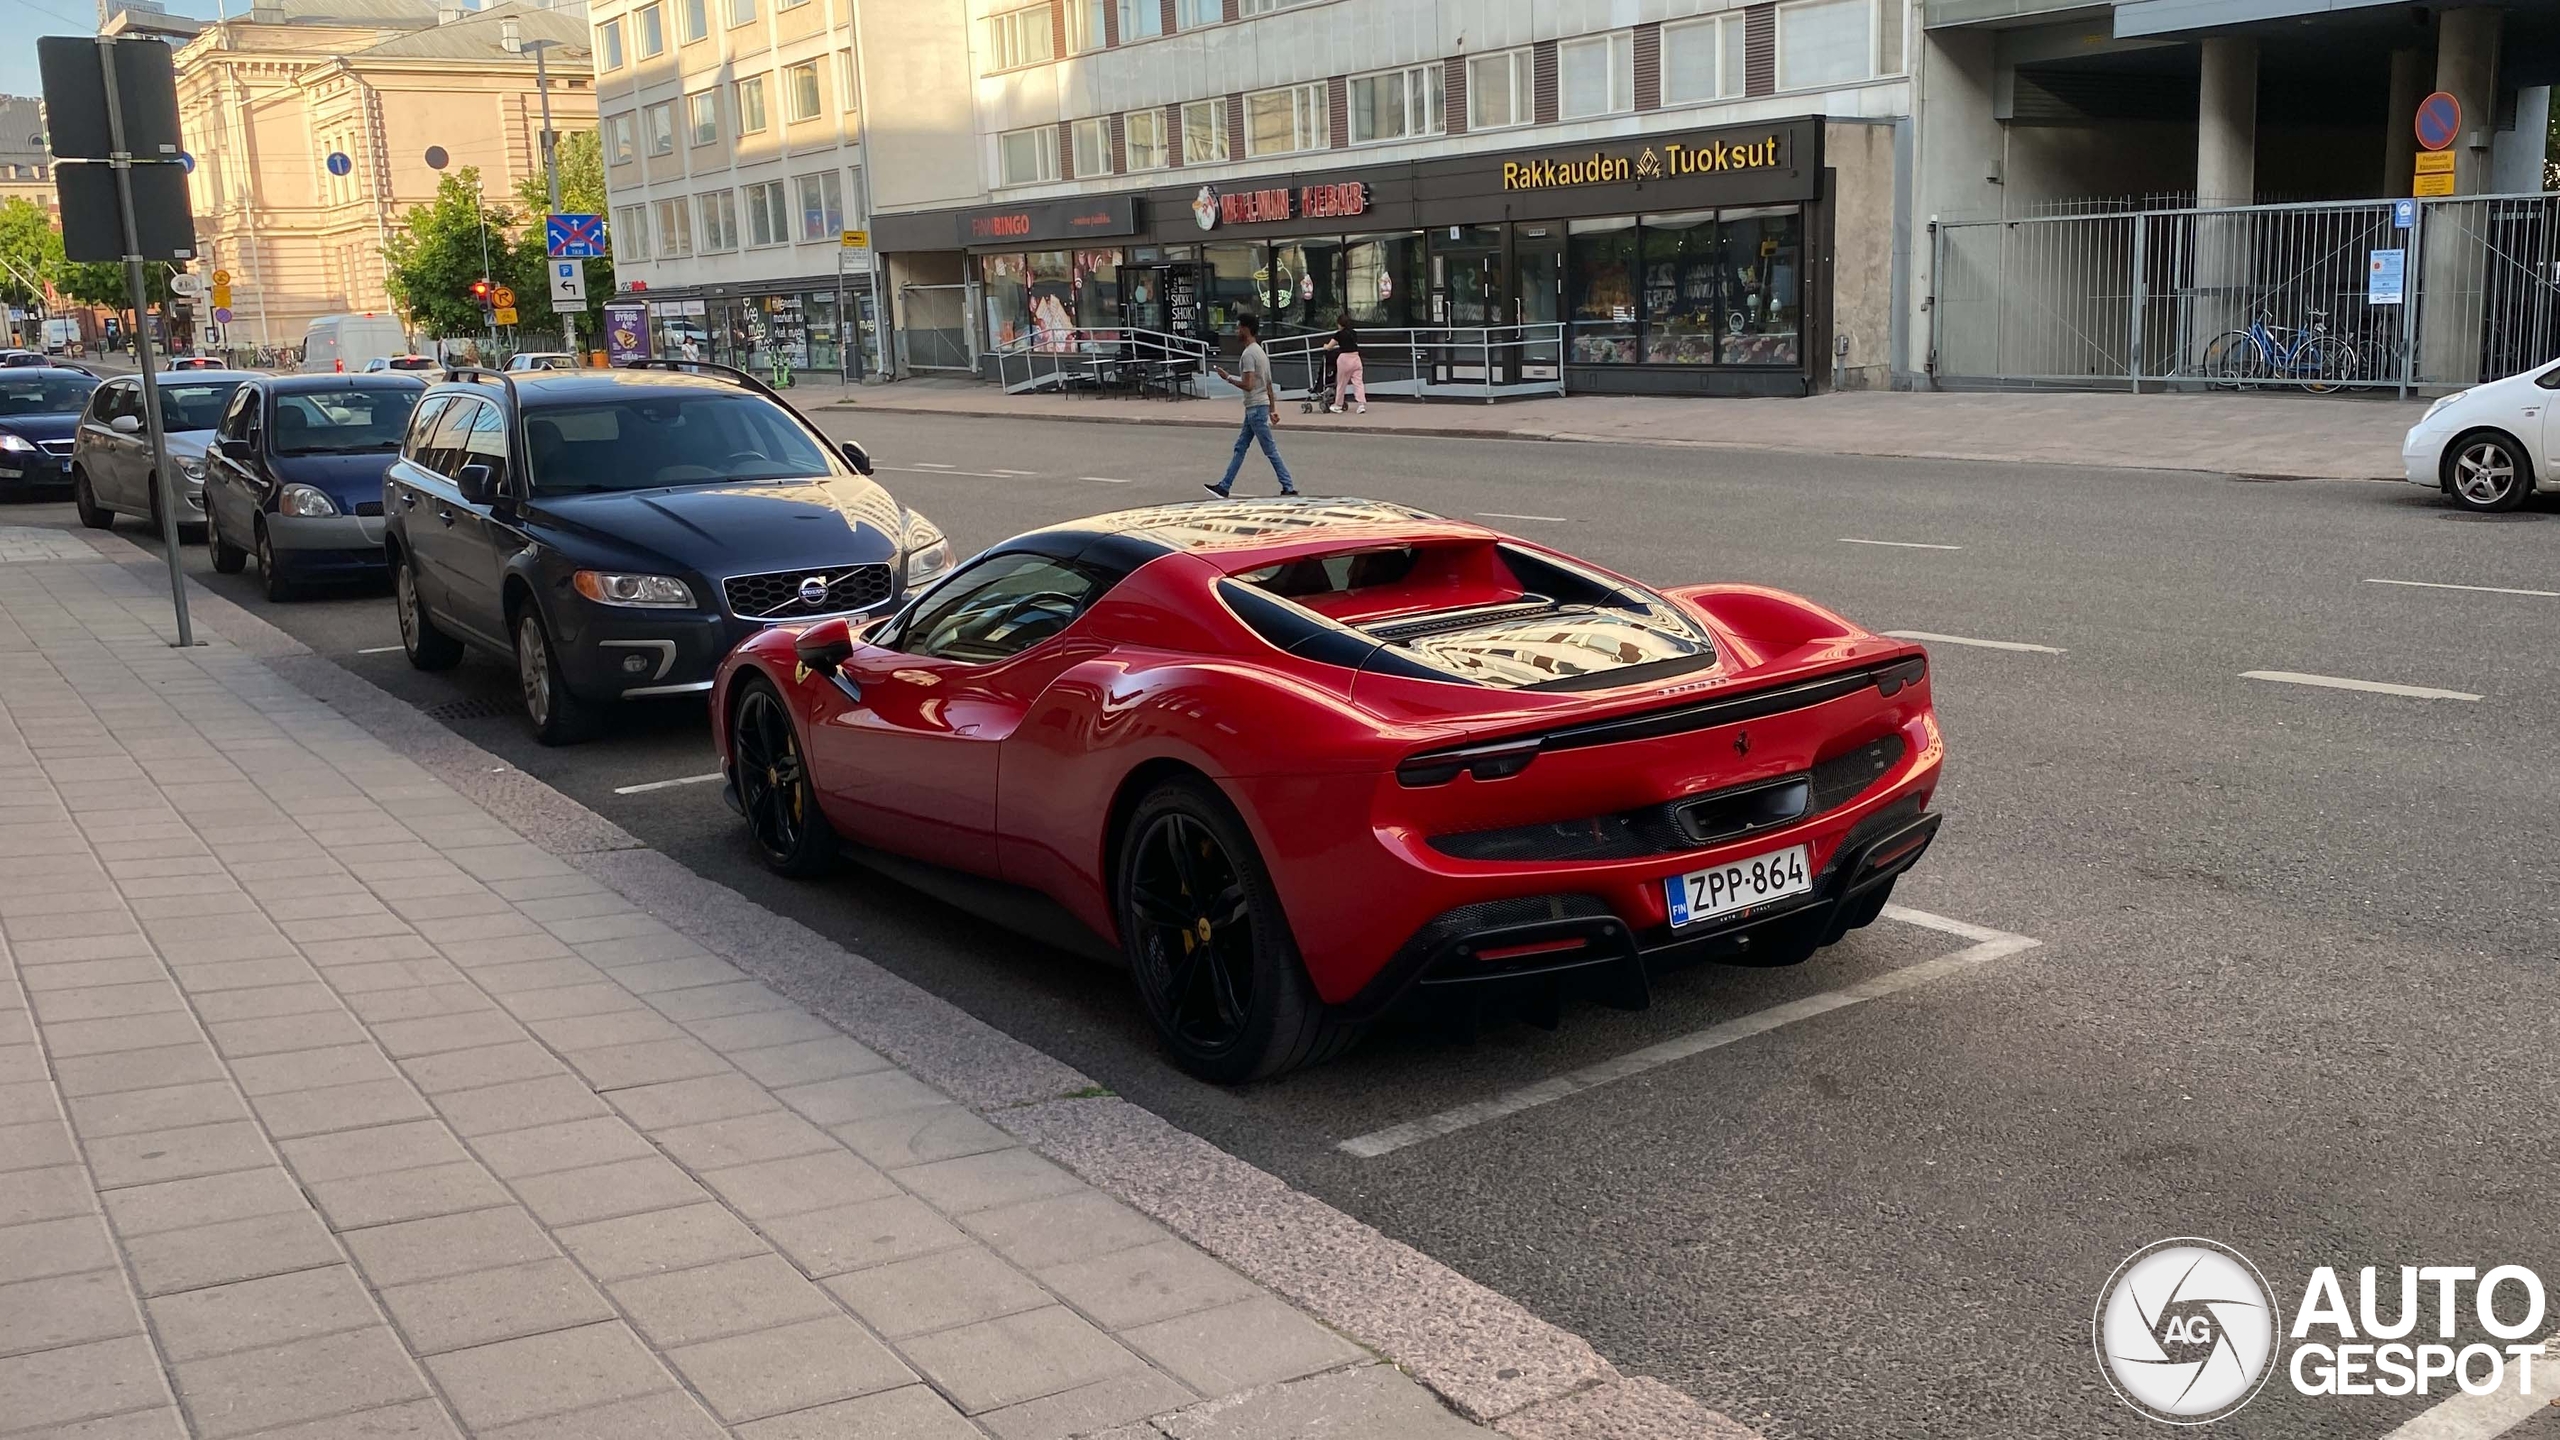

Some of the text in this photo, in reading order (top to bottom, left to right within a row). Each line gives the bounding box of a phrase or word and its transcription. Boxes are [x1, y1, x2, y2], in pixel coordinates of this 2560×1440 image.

[1503, 135, 1777, 190] Rakkauden Tuoksut
[1221, 181, 1364, 224] MALMIN KEBAB
[972, 213, 1031, 237] FINNBINGO
[614, 313, 638, 322] GYROS
[801, 588, 827, 596] VOLVO
[1672, 851, 1804, 917] FIN ZPP-864
